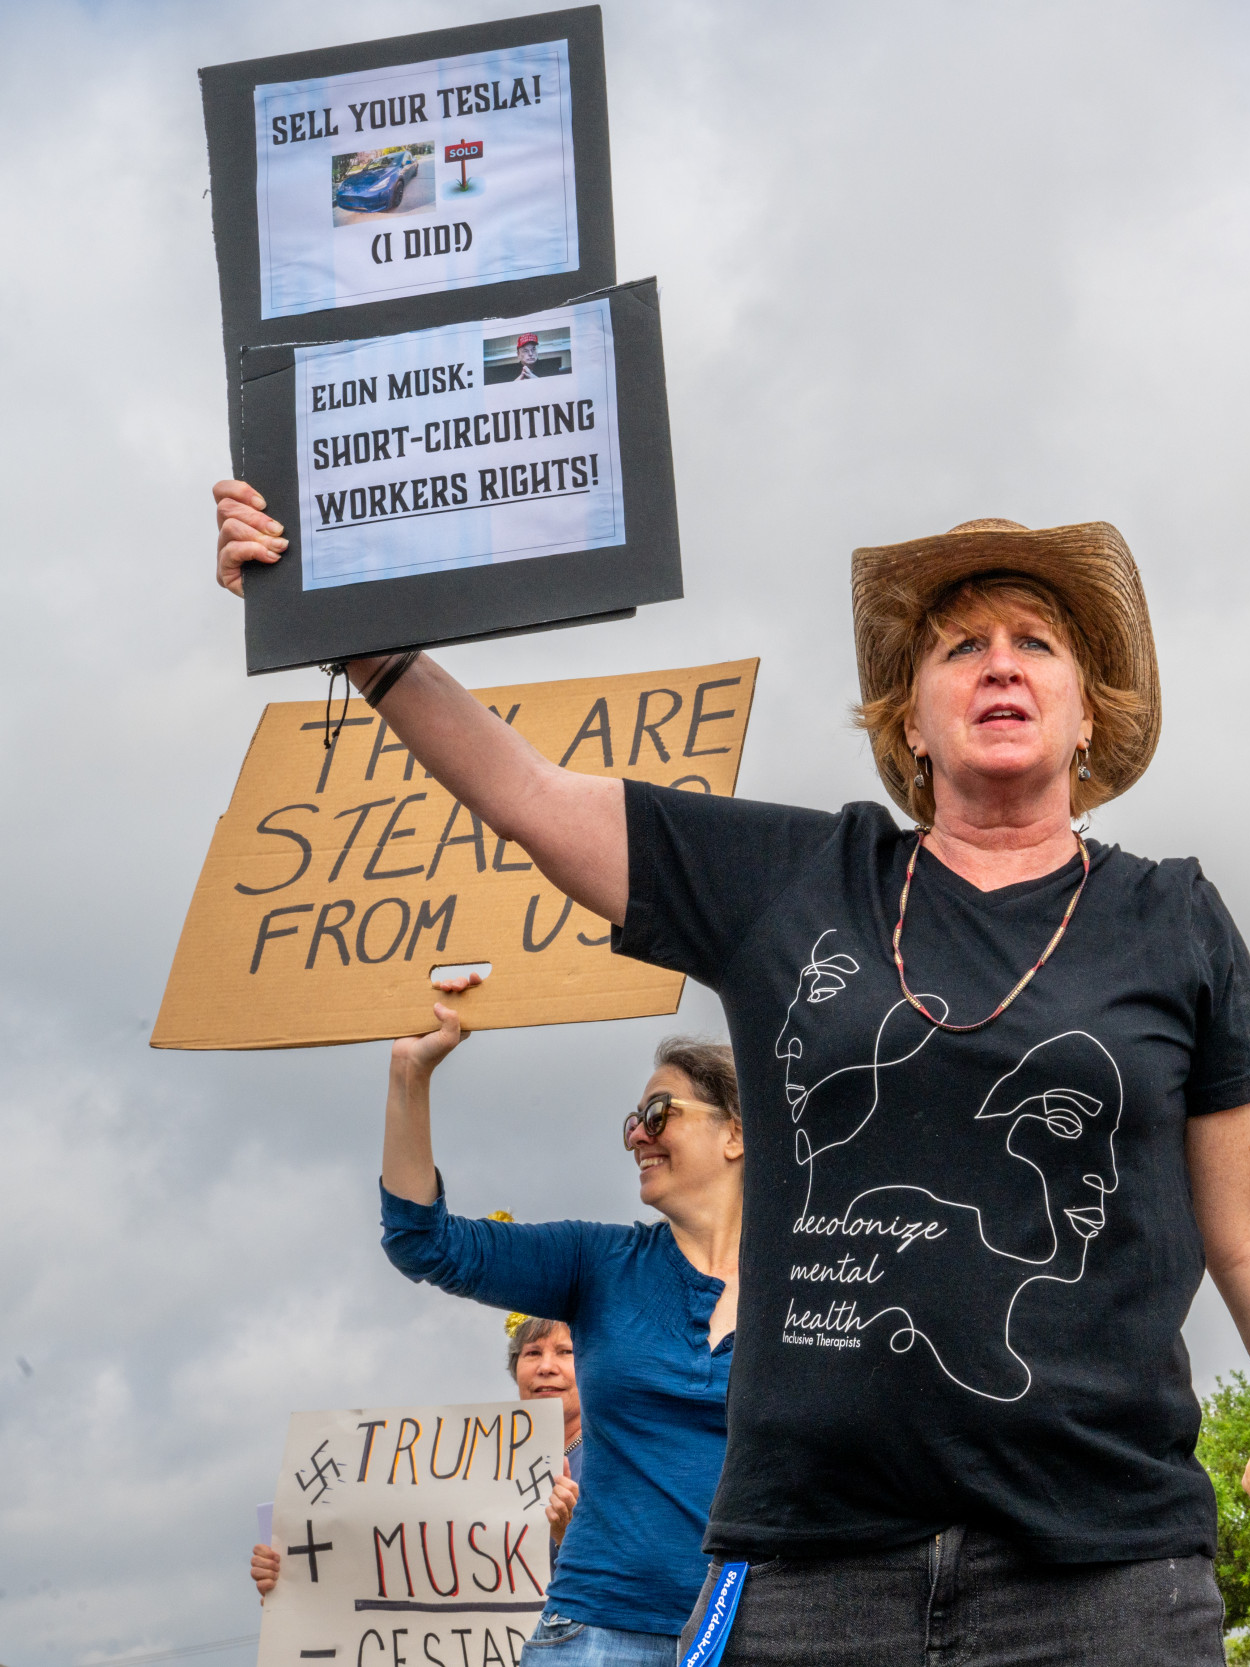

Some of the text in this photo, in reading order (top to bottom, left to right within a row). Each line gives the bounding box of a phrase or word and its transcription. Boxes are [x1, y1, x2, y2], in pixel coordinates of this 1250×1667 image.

[272, 74, 542, 146] SELL YOUR TESLA!
[449, 146, 479, 158] SOLD
[371, 221, 473, 265] (I DID!)
[311, 362, 474, 413] ELON MUSK:
[313, 399, 595, 470] SHORT-CIRCUITING
[315, 453, 599, 525] WORKERS RIGHTS!
[558, 676, 741, 769] ARE
[249, 893, 611, 974] FROM U
[792, 1215, 947, 1253] decolonize
[790, 1253, 884, 1284] mental
[782, 1331, 861, 1350] Inclusive Therapists
[784, 1298, 864, 1333] health
[356, 1409, 534, 1486] TRUMP
[372, 1520, 545, 1599] MUSK
